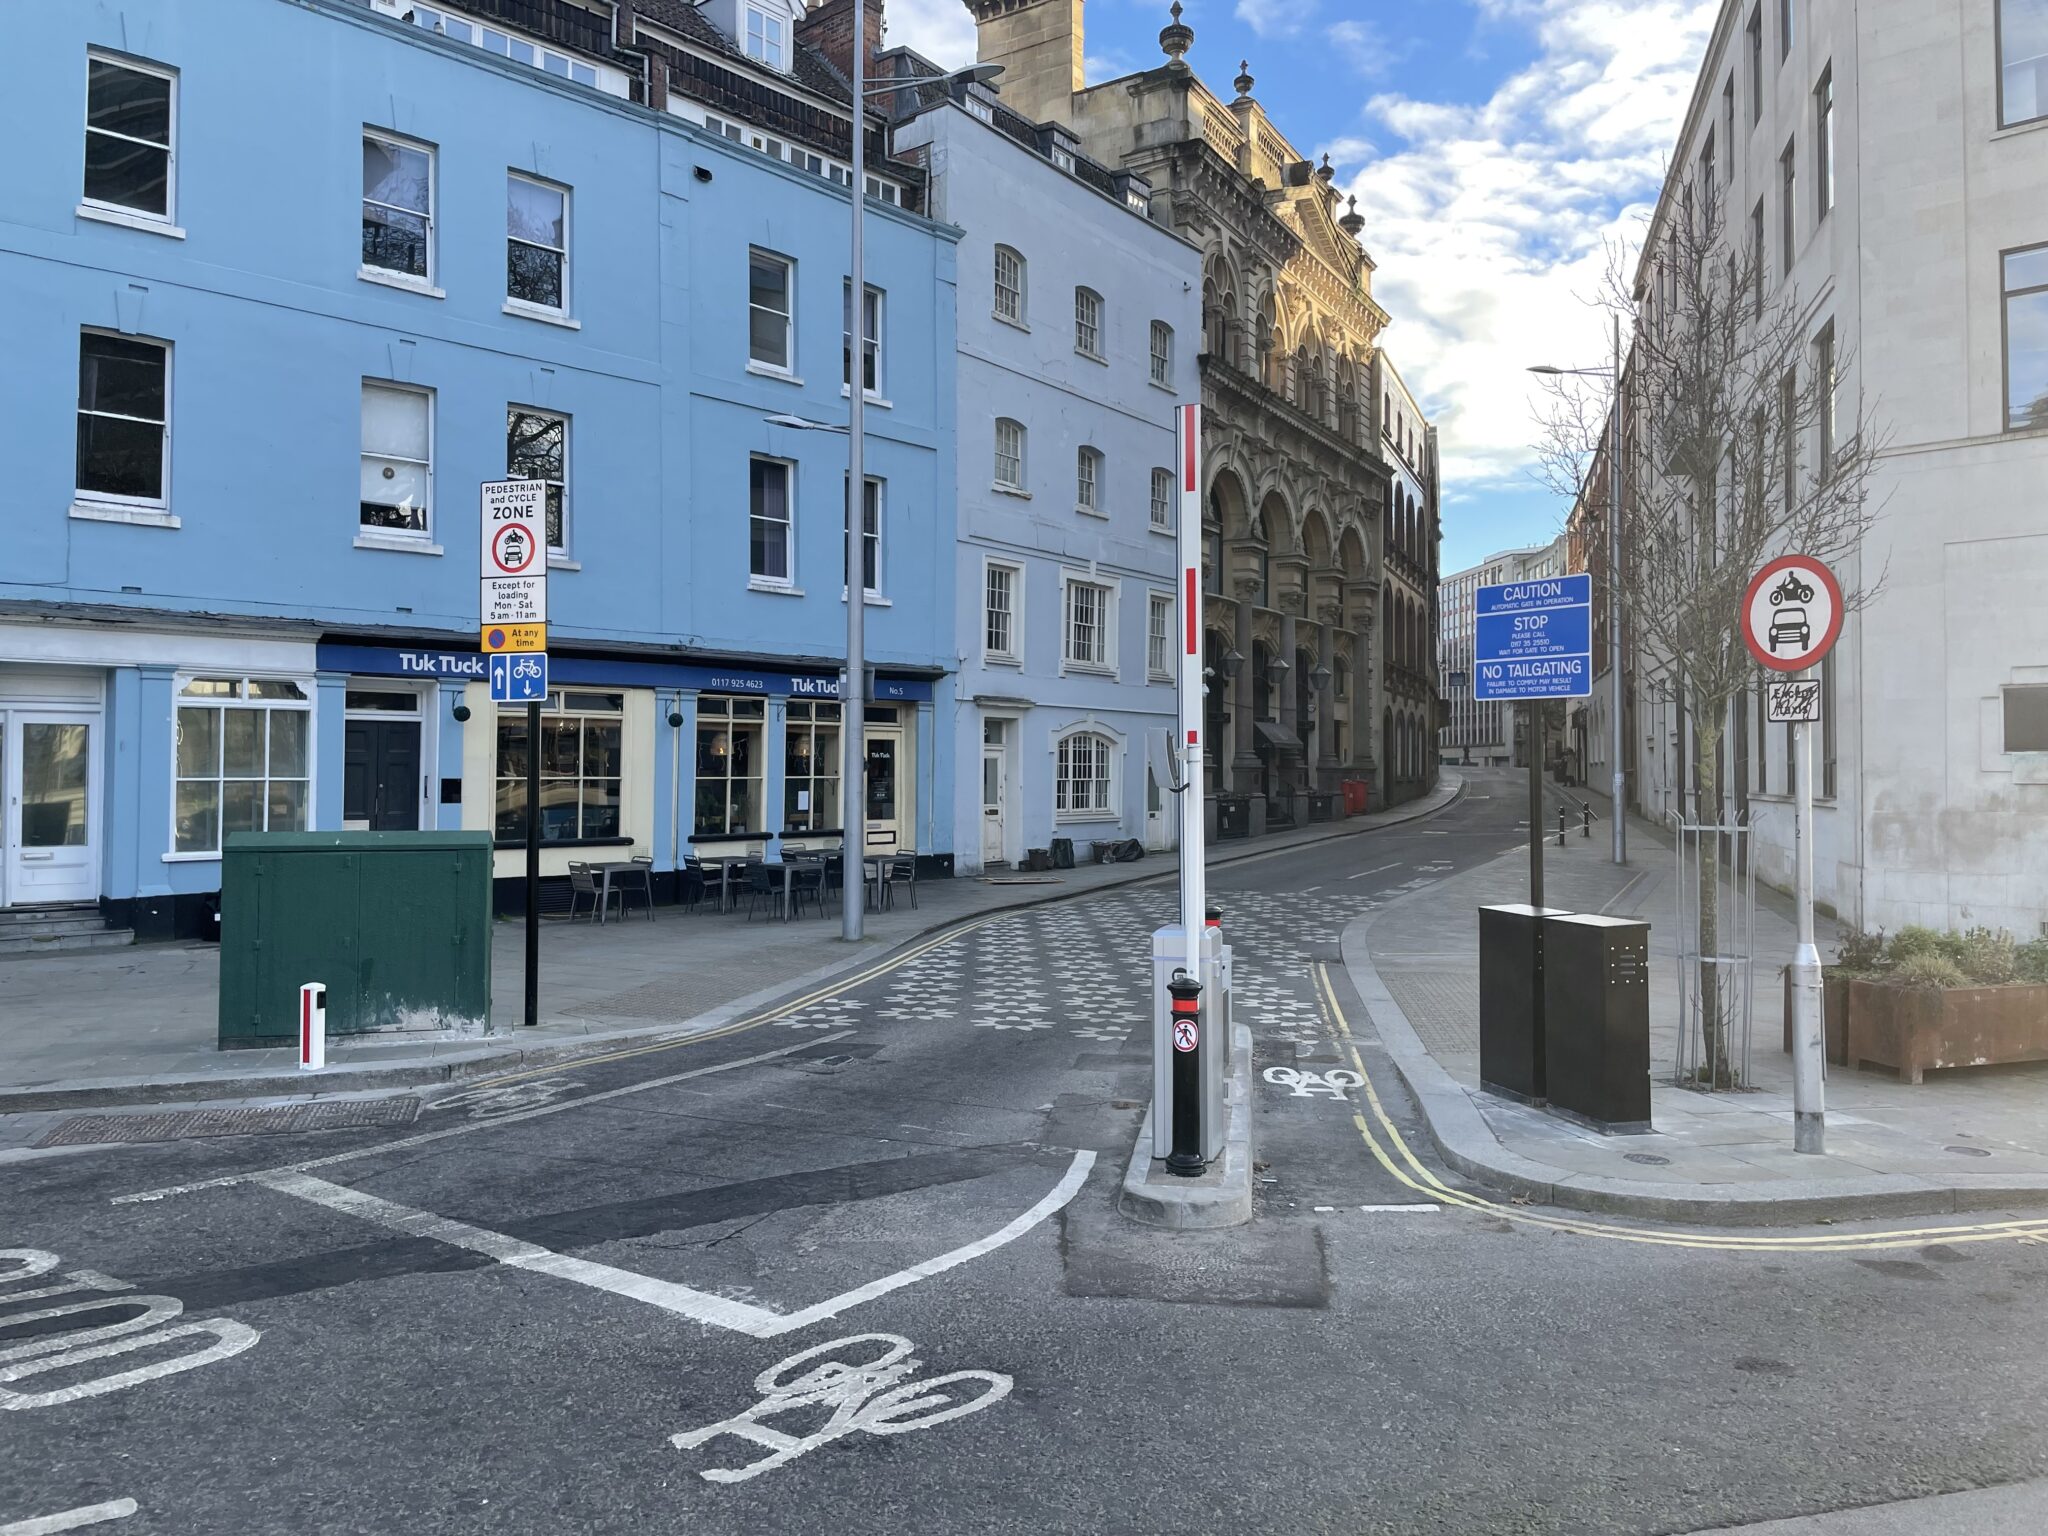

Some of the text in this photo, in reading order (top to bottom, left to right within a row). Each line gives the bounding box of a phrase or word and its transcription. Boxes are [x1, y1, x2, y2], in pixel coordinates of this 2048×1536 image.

[485, 483, 542, 494] PEDESTRIAN
[490, 494, 537, 504] and CYCLE
[493, 505, 534, 520] ZONE
[492, 580, 535, 590] Except for
[498, 591, 528, 600] loading
[1503, 582, 1561, 601] CAUTION
[494, 601, 512, 610] Mon
[518, 600, 533, 609] Sat
[1491, 602, 1519, 611] AUTOMATIC
[1544, 597, 1574, 605] OPERATION
[1514, 615, 1548, 631] STOP
[524, 630, 538, 638] any
[1512, 632, 1531, 640] PLEASE
[516, 639, 534, 647] time
[400, 653, 484, 674] Tuk Tuck
[1482, 659, 1582, 680] NO TAILGATING
[712, 678, 764, 689] 0117 925 4623
[792, 678, 839, 694] Tuk Tuc
